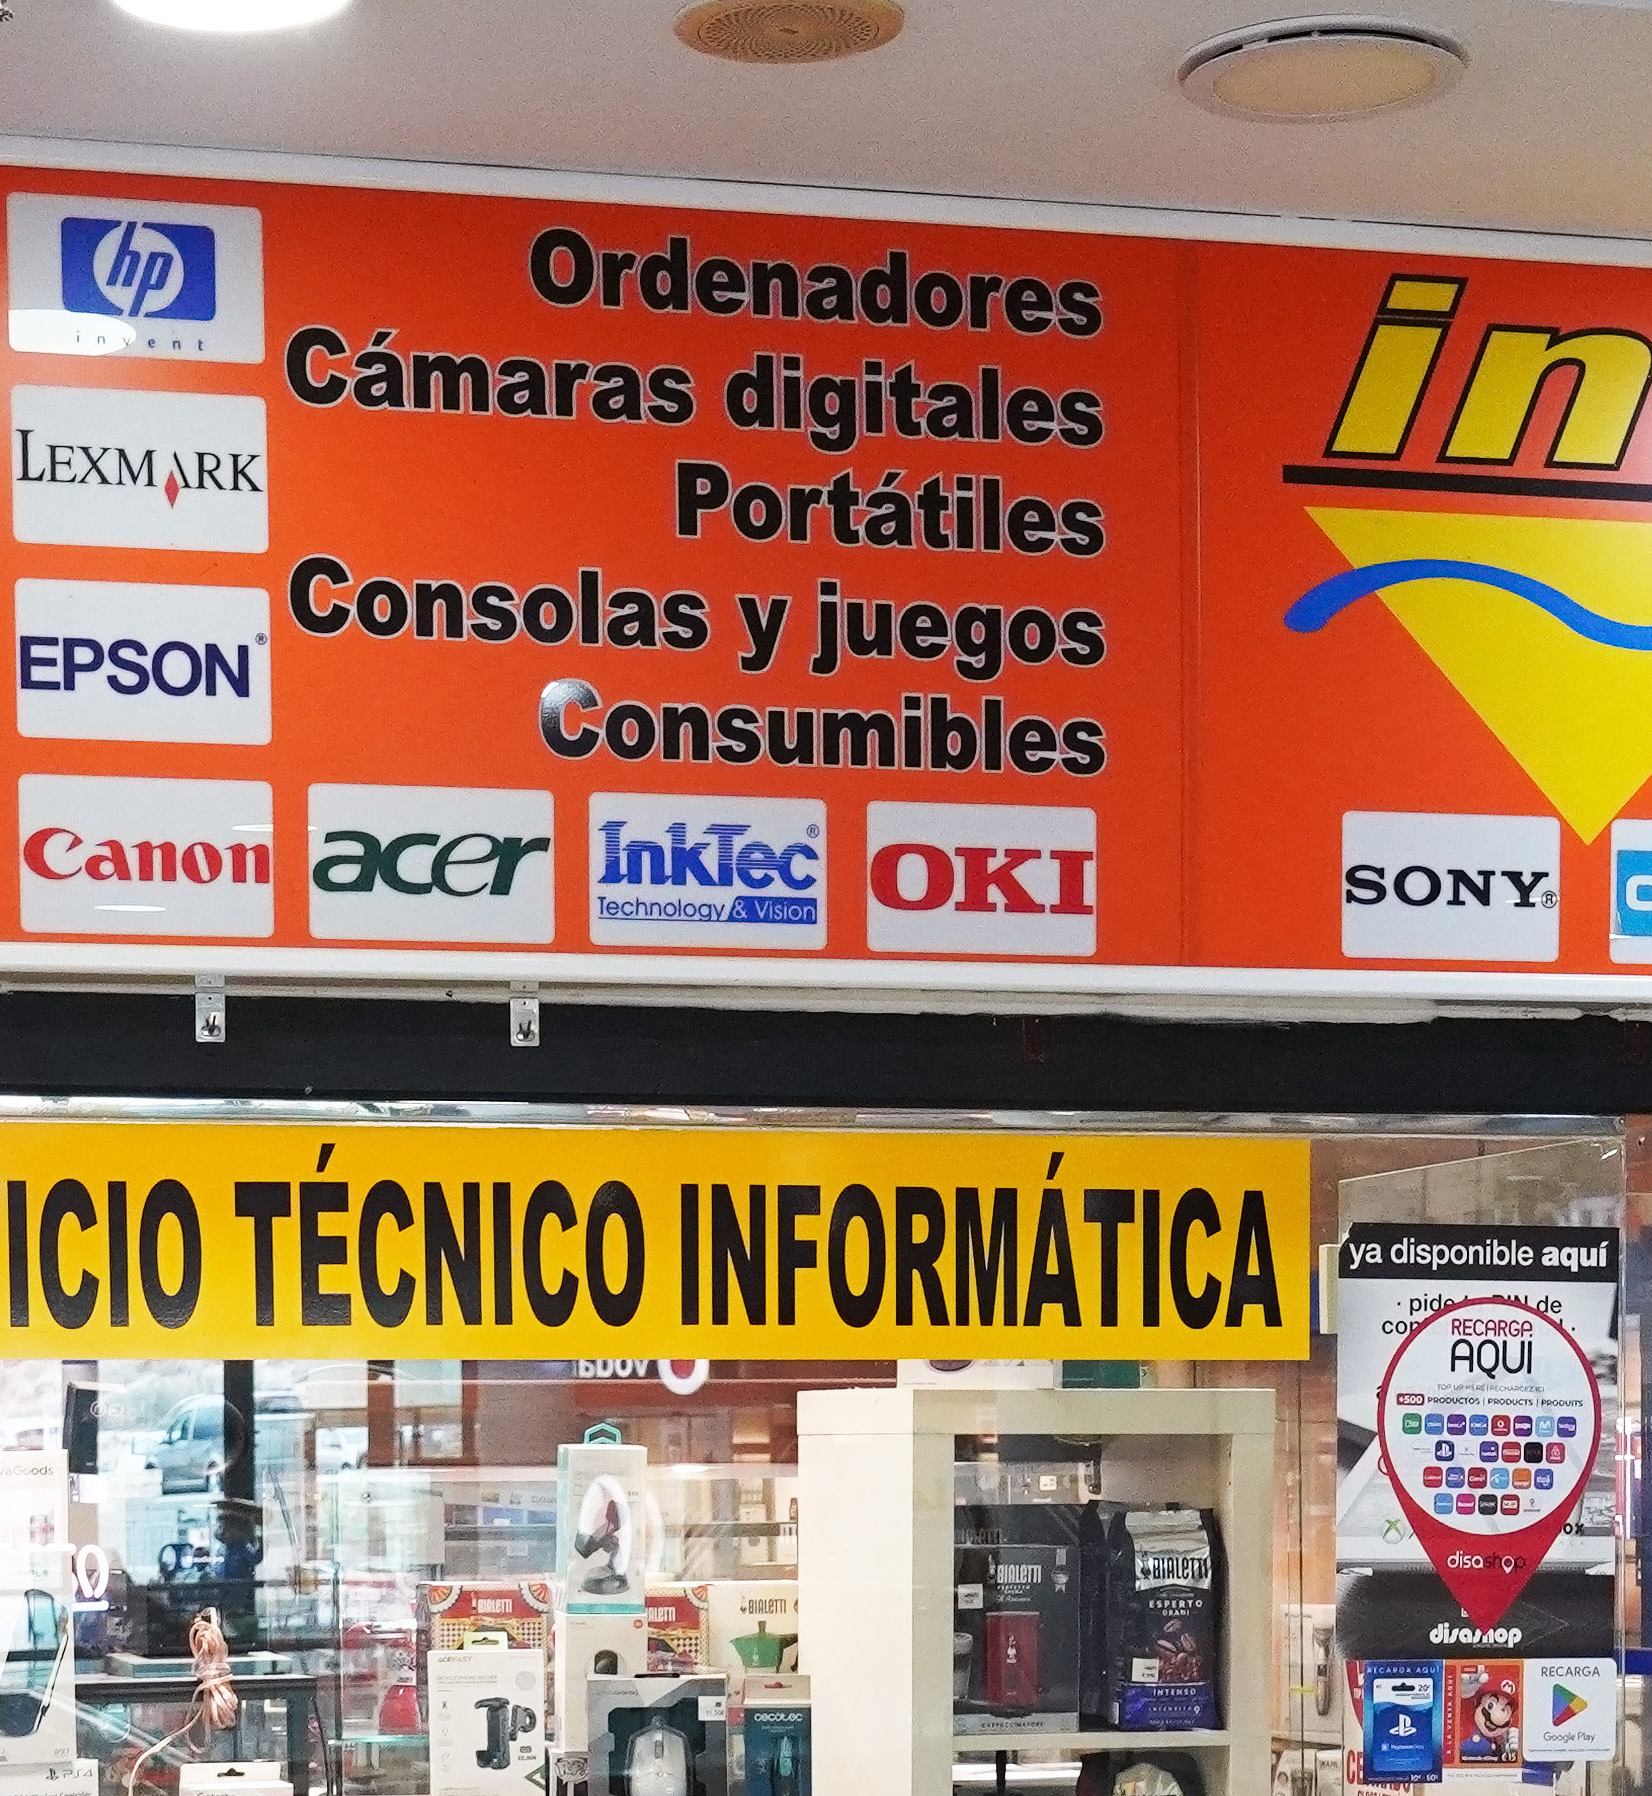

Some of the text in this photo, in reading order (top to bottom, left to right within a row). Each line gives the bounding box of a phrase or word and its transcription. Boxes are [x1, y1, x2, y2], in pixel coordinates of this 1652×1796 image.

[111, 222, 173, 301] hp
[531, 229, 1103, 336] Ordenadores
[285, 328, 1104, 452] Cámaras digitales
[15, 428, 263, 494] LEXMARK
[676, 462, 1104, 557] Portátiles
[287, 556, 1104, 681] Consolas y juegos
[19, 635, 251, 697] EPSON
[541, 679, 1106, 775] Consumibles
[24, 826, 270, 884] Canon
[316, 828, 549, 895] acer
[598, 820, 817, 890] InkTec
[870, 844, 1094, 915] OKI
[1345, 865, 1549, 906] SONY
[598, 896, 816, 923] Technology & Vision
[235, 1144, 644, 1328] TÉCNICO
[680, 1153, 1282, 1329] INFORMÁTICA
[1349, 1239, 1608, 1272] ya disponible aquí
[1451, 1319, 1532, 1337] RECARGA
[1541, 1666, 1600, 1677] RECARGA
[1543, 1731, 1595, 1744] Google Play
